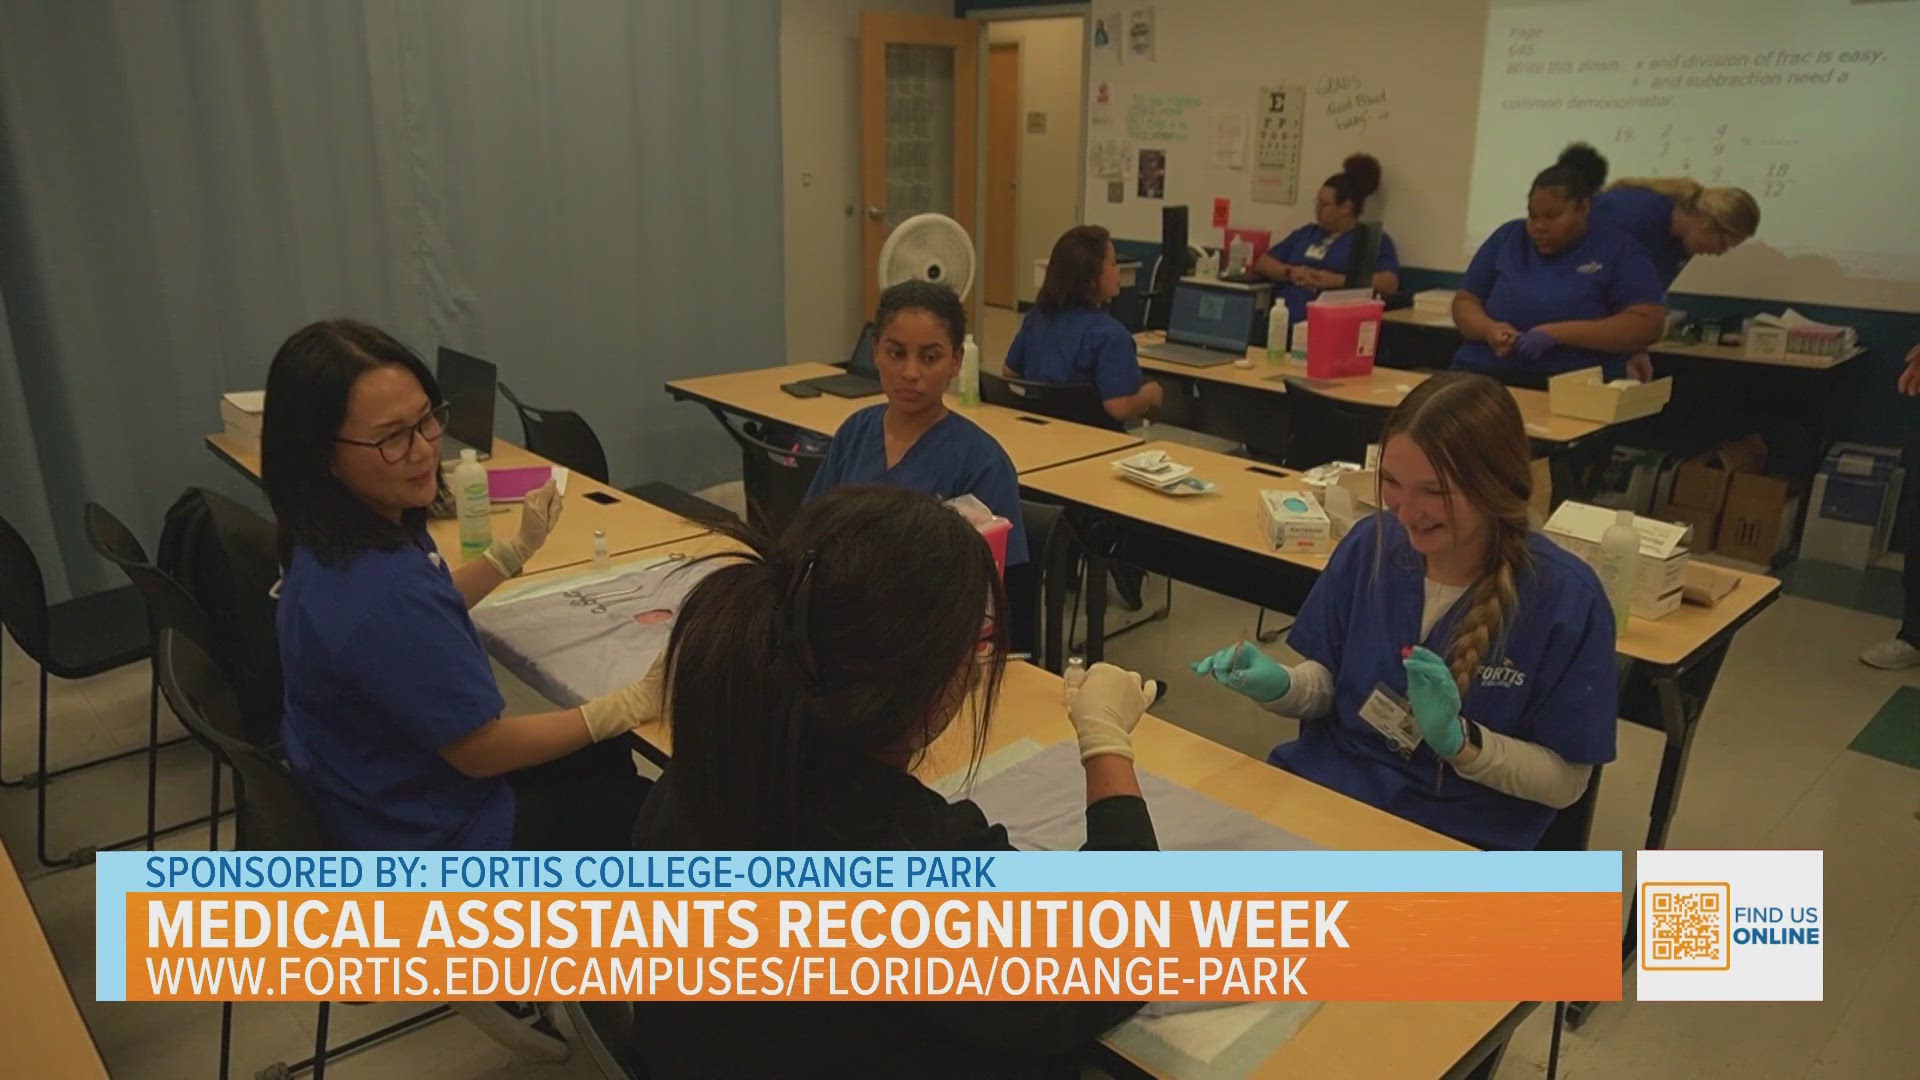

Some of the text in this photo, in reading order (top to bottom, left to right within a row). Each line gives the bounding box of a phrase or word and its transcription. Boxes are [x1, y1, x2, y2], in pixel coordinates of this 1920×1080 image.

[1648, 54, 1679, 70] and
[1683, 53, 1748, 68] division
[1753, 50, 1774, 67] of
[1776, 49, 1812, 66] frac
[1815, 49, 1833, 64] is
[1838, 49, 1887, 66] easy.
[1651, 73, 1682, 89] and
[1685, 72, 1782, 89] subtraction
[1787, 67, 1835, 85] need
[1837, 71, 1850, 84] a
[1269, 91, 1286, 114] E
[1766, 162, 1790, 178] 18
[1474, 664, 1527, 687] FORTIS
